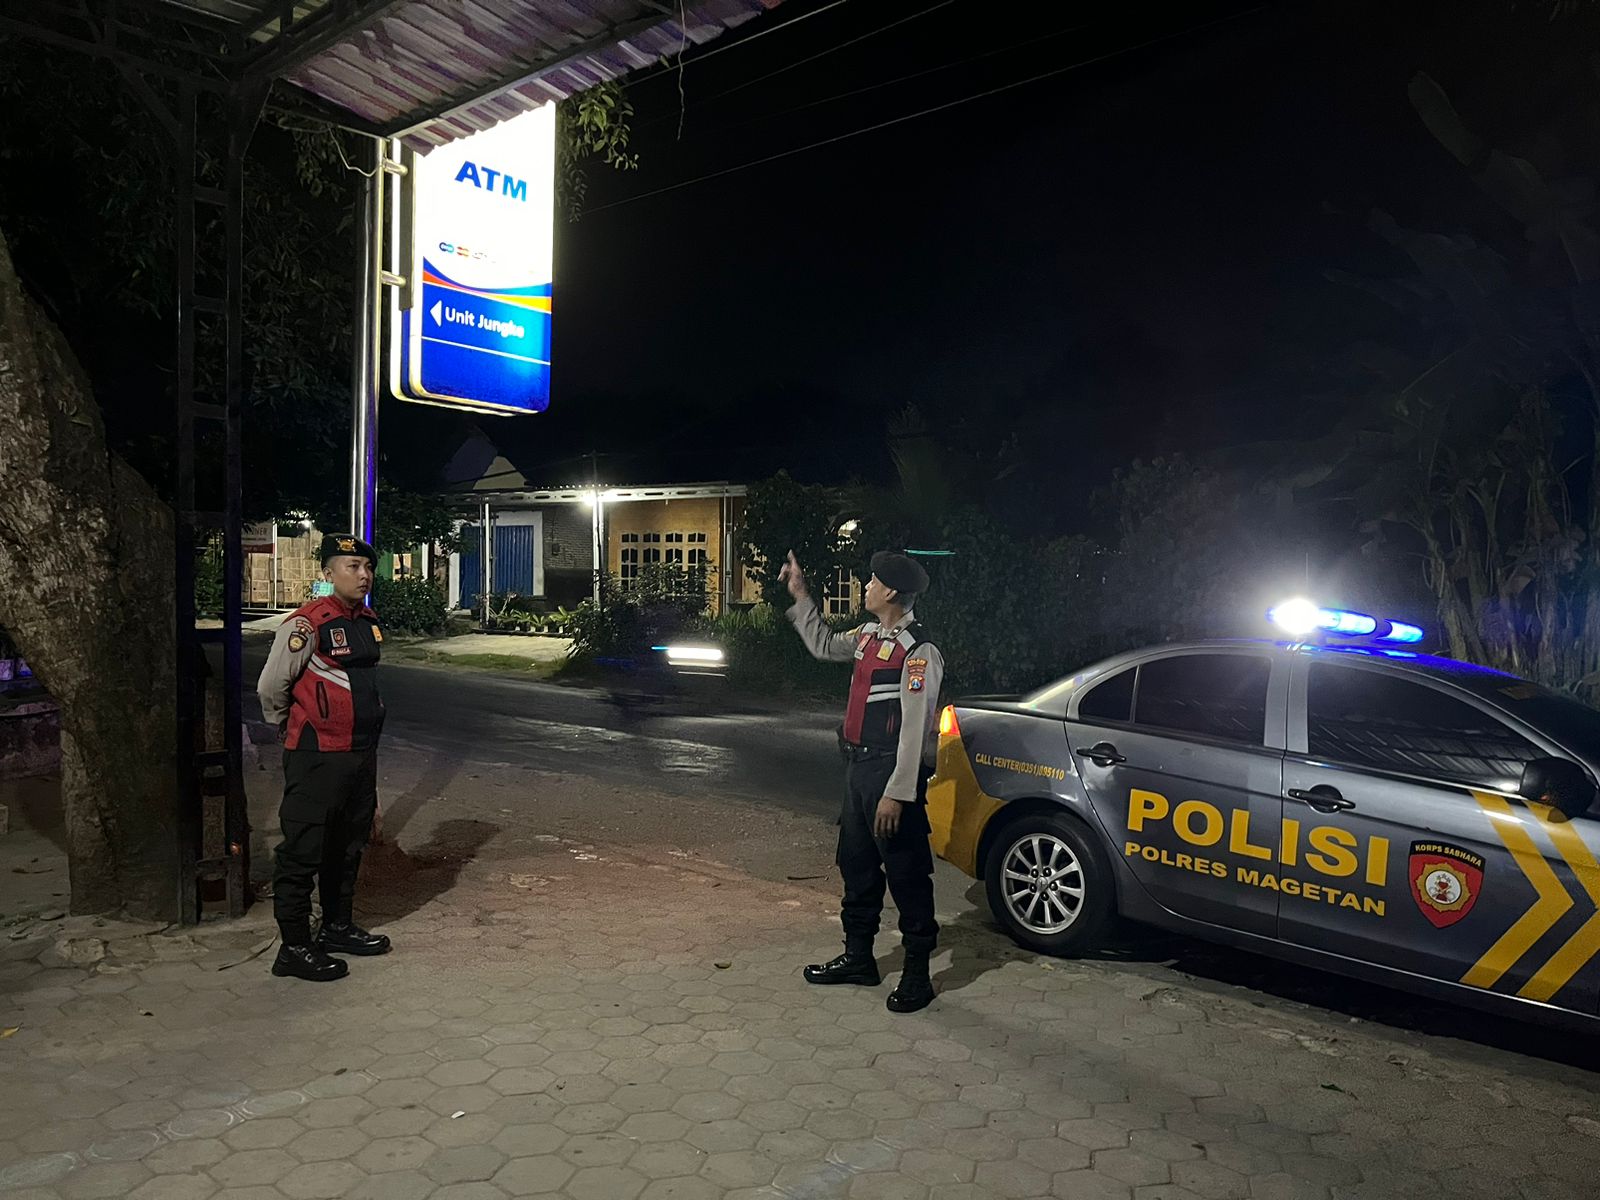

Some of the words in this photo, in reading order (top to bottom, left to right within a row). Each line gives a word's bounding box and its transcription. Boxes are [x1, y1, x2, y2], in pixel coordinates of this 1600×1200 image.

[455, 161, 527, 202] ATM
[445, 307, 475, 326] Unit
[975, 753, 992, 766] CALL
[1127, 788, 1390, 887] POLISI
[1415, 844, 1443, 853] KORPS
[1444, 847, 1482, 867] SABHARA
[1124, 841, 1229, 879] POLRES
[1236, 867, 1386, 917] MAGETAN
